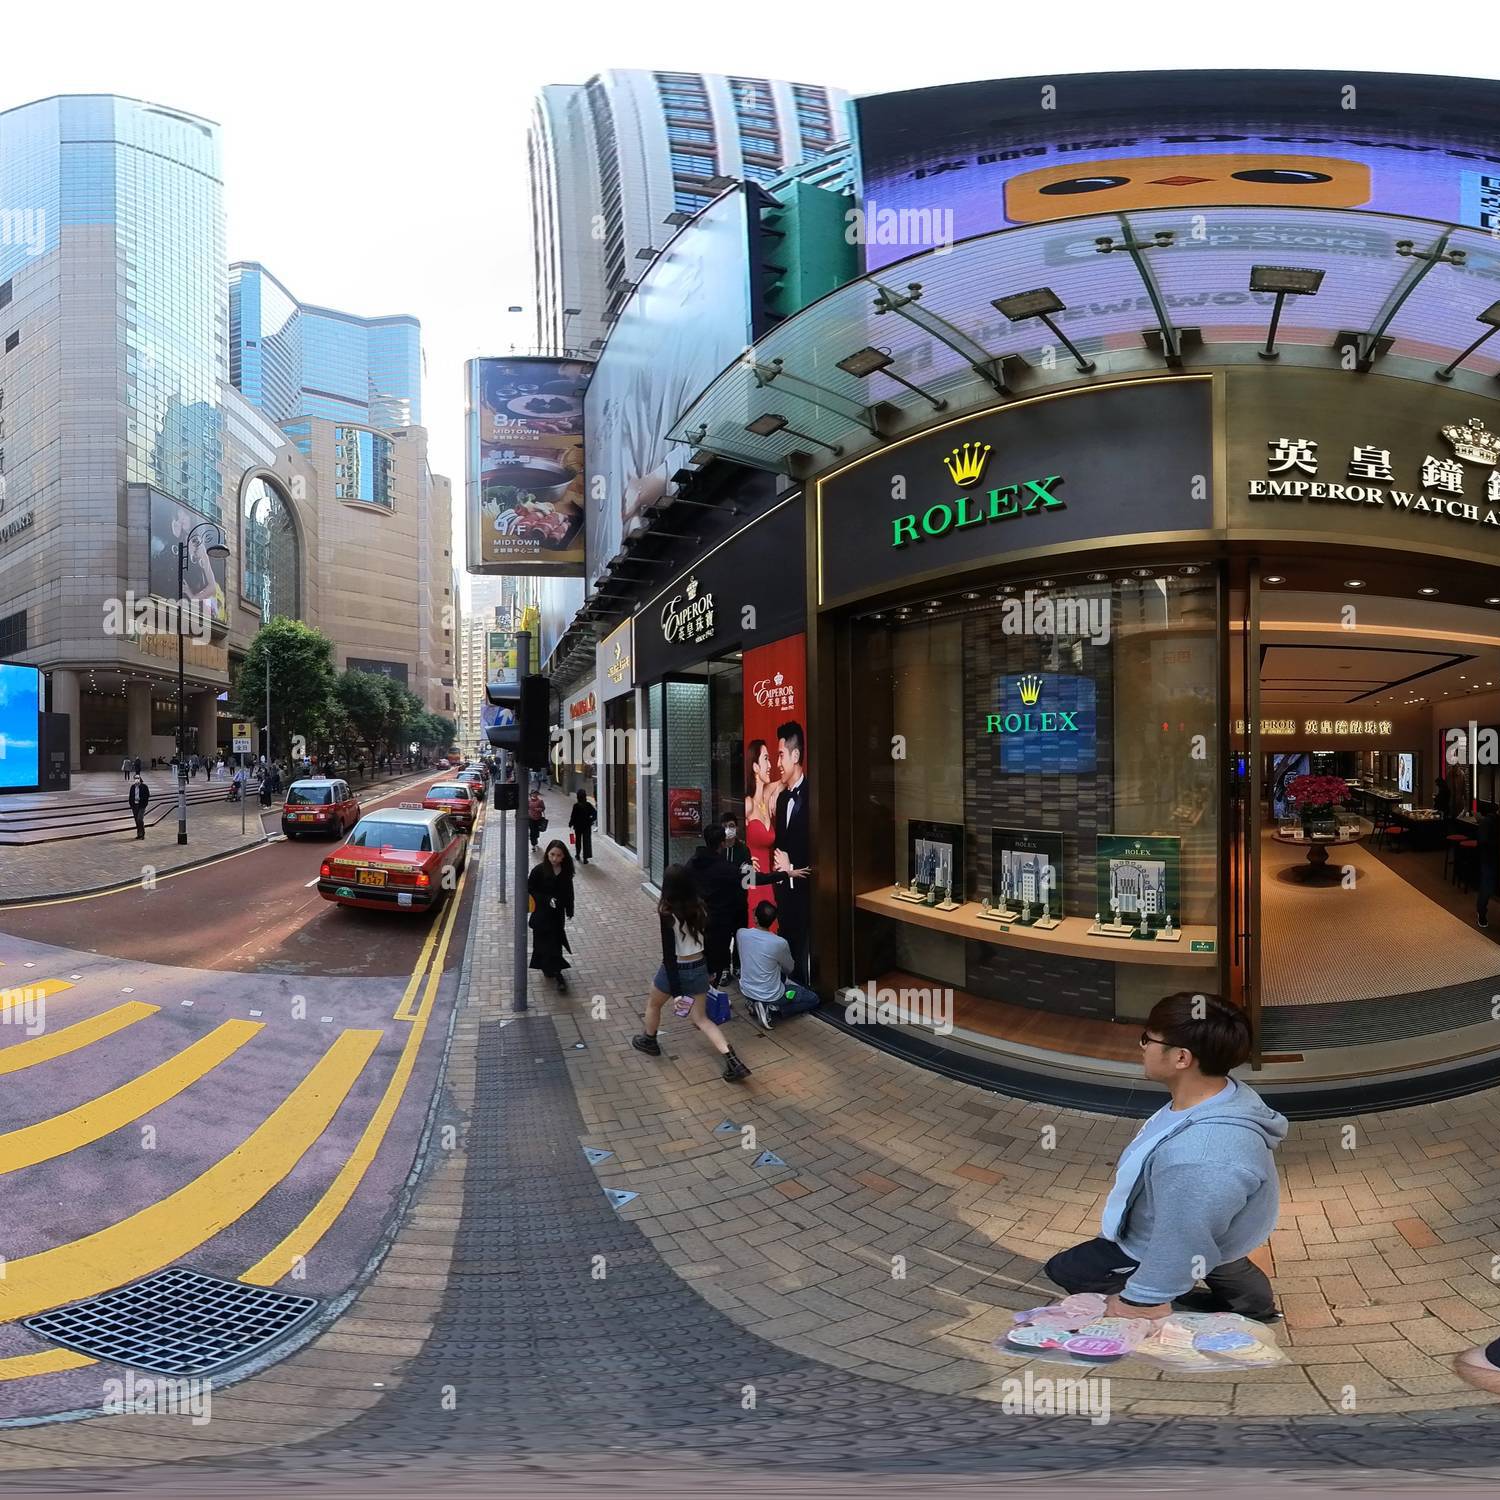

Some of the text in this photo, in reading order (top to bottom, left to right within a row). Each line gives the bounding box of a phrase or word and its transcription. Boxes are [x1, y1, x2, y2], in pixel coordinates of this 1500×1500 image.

[494, 413, 527, 427] 8/F
[890, 475, 1067, 549] ROLEX
[1249, 479, 1384, 505] EMPEROR
[1390, 492, 1479, 521] WATCH
[0, 511, 34, 543] QUARE
[494, 515, 527, 536] 9/F
[661, 593, 714, 643] EMPEROR
[678, 610, 714, 641] 英皇珠寶
[752, 680, 794, 706] EMPEROR
[768, 694, 794, 708] 英皇珠寶
[986, 711, 1079, 734] ROLEX
[1236, 719, 1296, 729] EEROR
[1015, 841, 1038, 849] ROLEX
